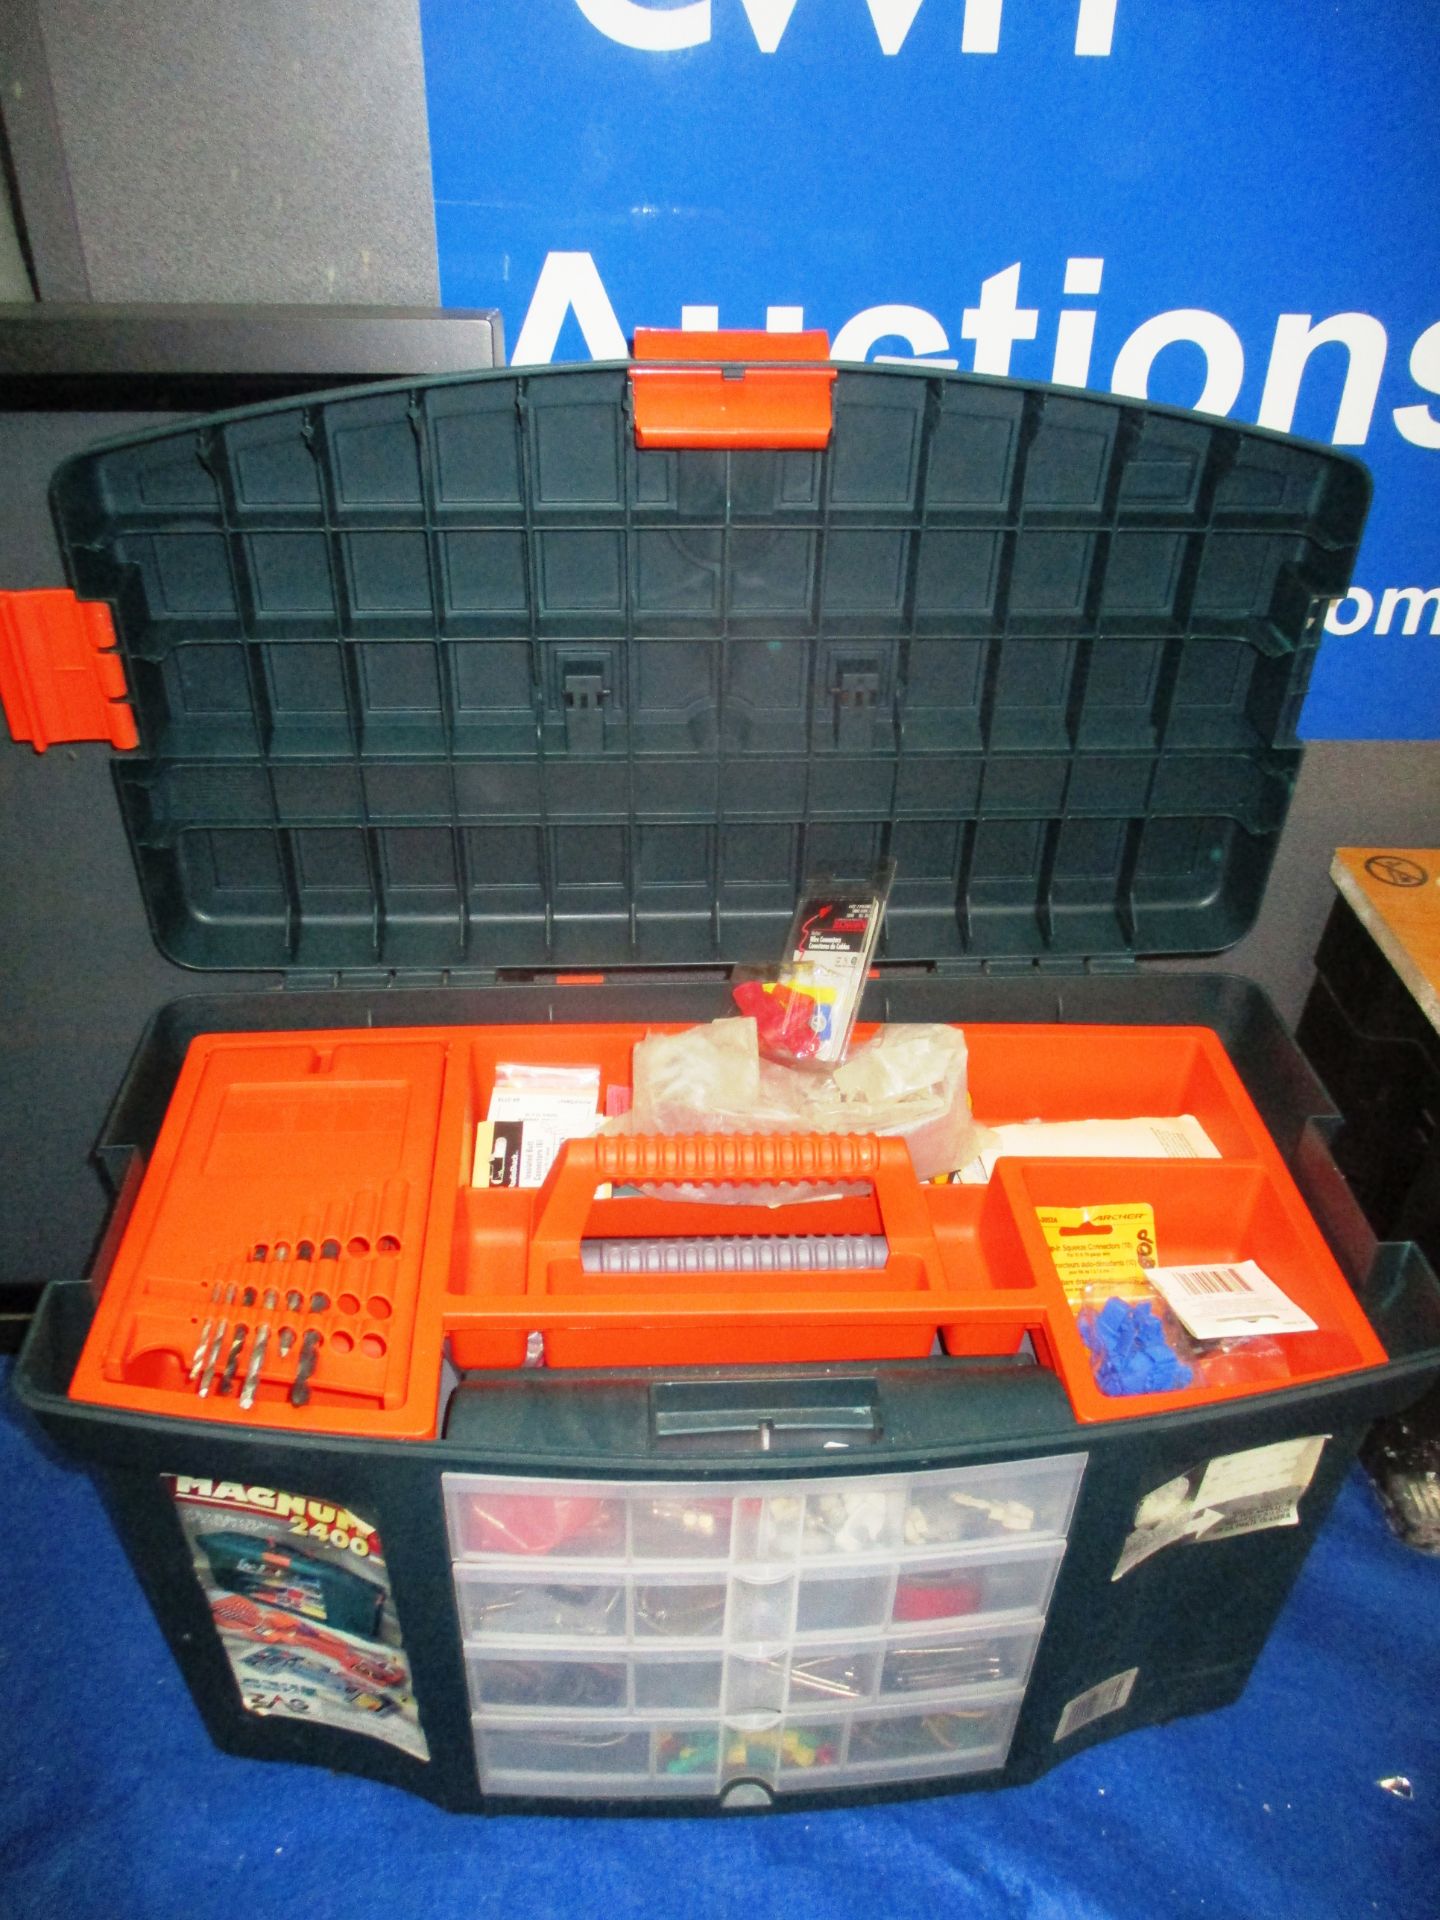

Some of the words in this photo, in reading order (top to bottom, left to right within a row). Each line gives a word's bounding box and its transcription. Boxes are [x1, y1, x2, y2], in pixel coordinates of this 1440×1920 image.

[510, 251, 1440, 450] Ation
[1306, 586, 1440, 636] om
[1093, 1213, 1147, 1222] ARCHER
[1062, 1243, 1086, 1252] Squeeze
[1088, 1241, 1121, 1250] Connectors
[175, 1475, 377, 1534] MAGNUM
[288, 1515, 369, 1557] 2400
